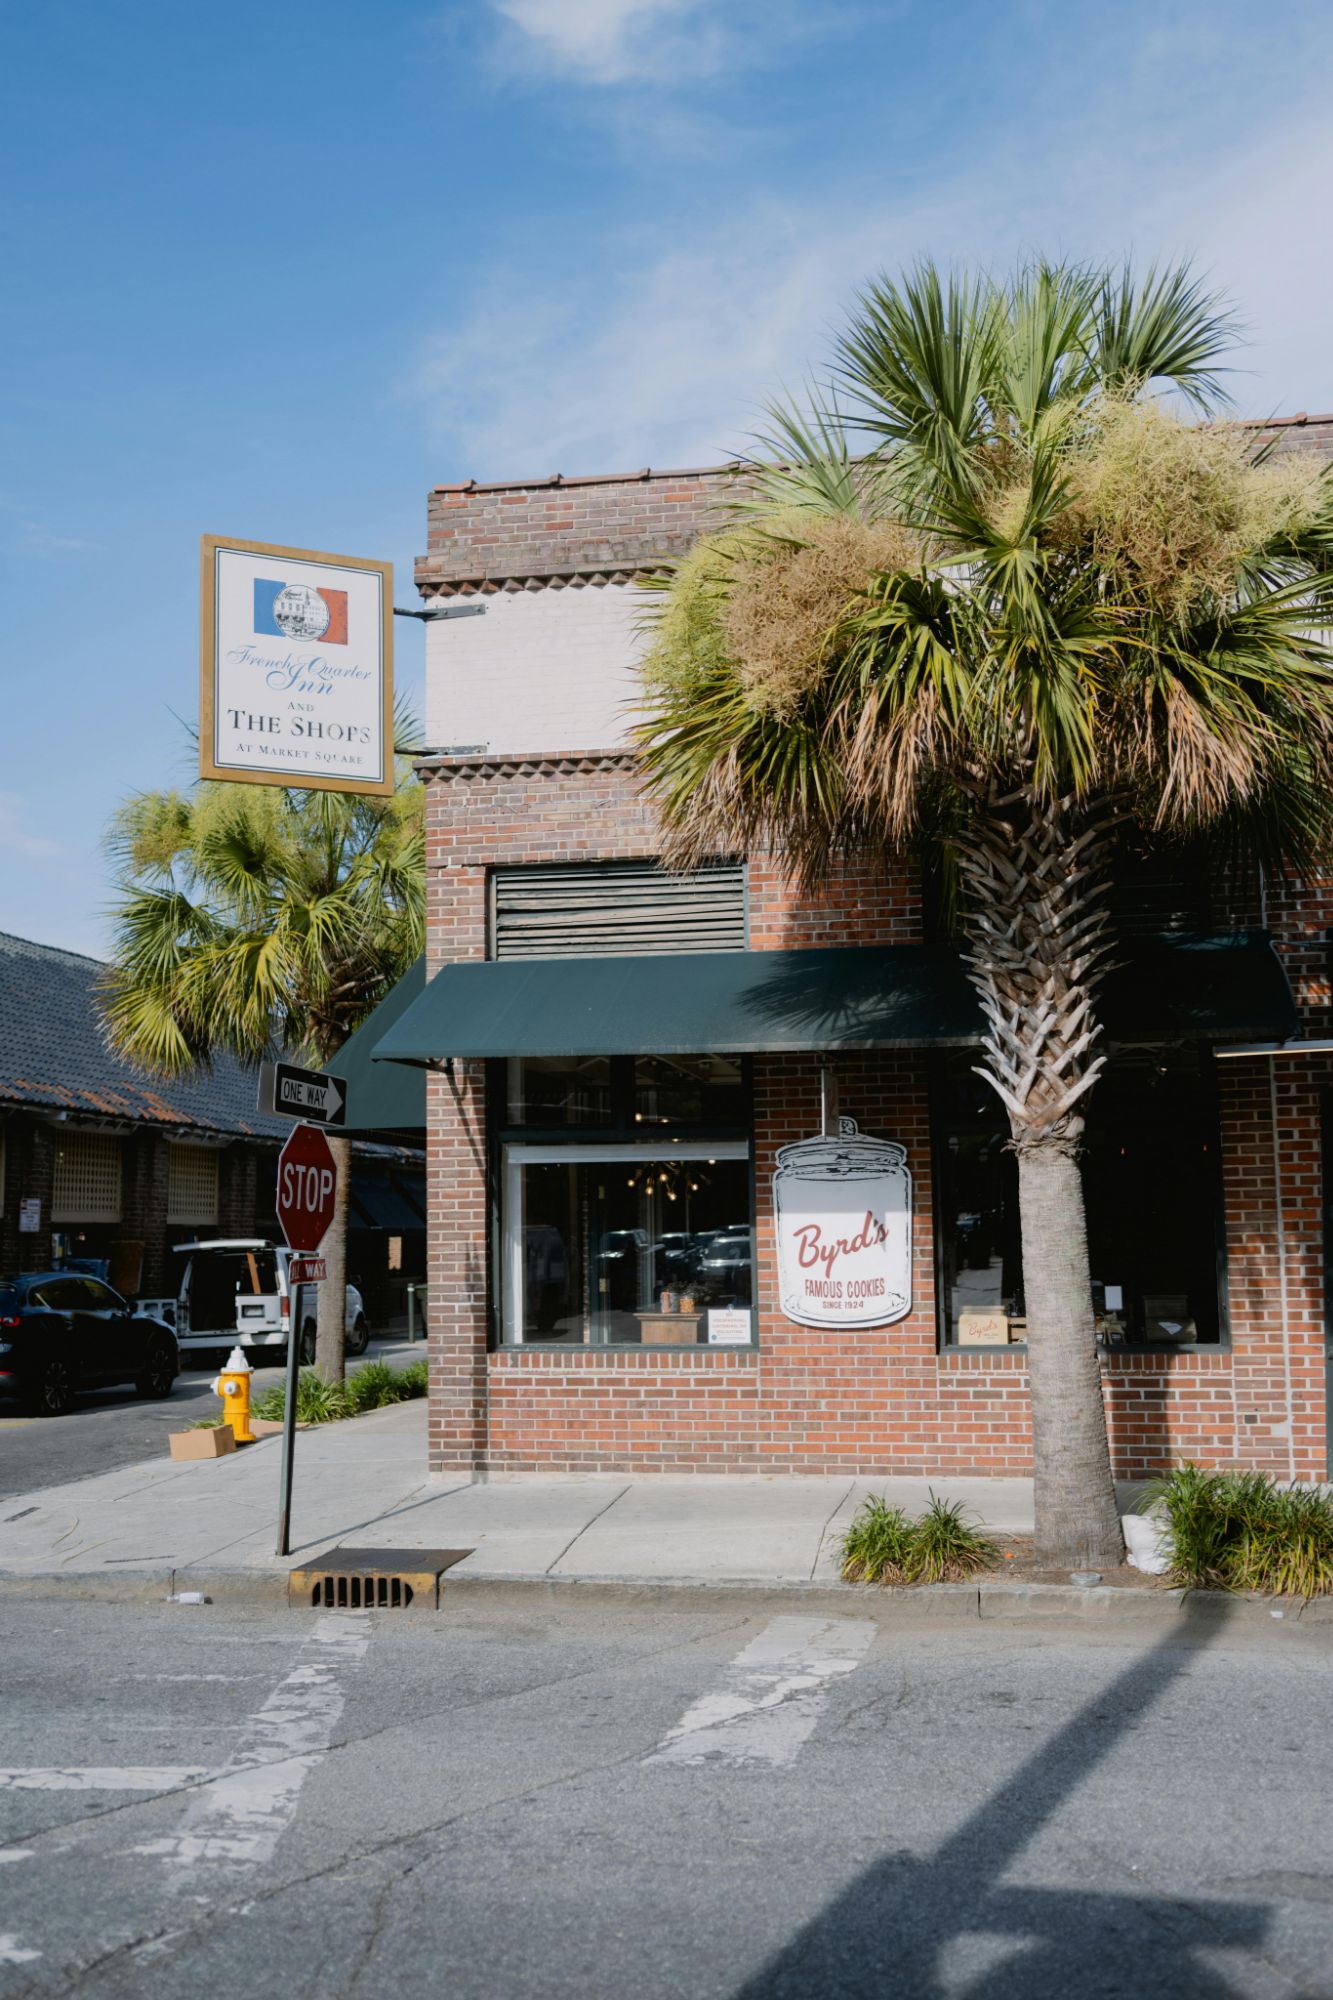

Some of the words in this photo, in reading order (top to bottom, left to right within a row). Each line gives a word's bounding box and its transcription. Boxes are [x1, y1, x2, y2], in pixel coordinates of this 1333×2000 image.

[226, 645, 291, 670] French
[297, 654, 372, 681] Quarter
[266, 662, 334, 695] Inn
[287, 701, 315, 712] AND
[227, 709, 281, 734] THE
[290, 716, 371, 744] SHOPS
[236, 743, 253, 752] AT
[259, 745, 309, 758] MARKET
[315, 751, 364, 764] SQUARE
[283, 1080, 303, 1101] ONE
[307, 1084, 327, 1107] WAY
[282, 1162, 333, 1213] STOP
[793, 1210, 889, 1279] Byrd's
[305, 1263, 325, 1279] WAY
[804, 1279, 843, 1298] FAMOUS
[846, 1277, 885, 1298] COOKIES
[822, 1301, 842, 1309] SINCE
[844, 1300, 864, 1309] 1924
